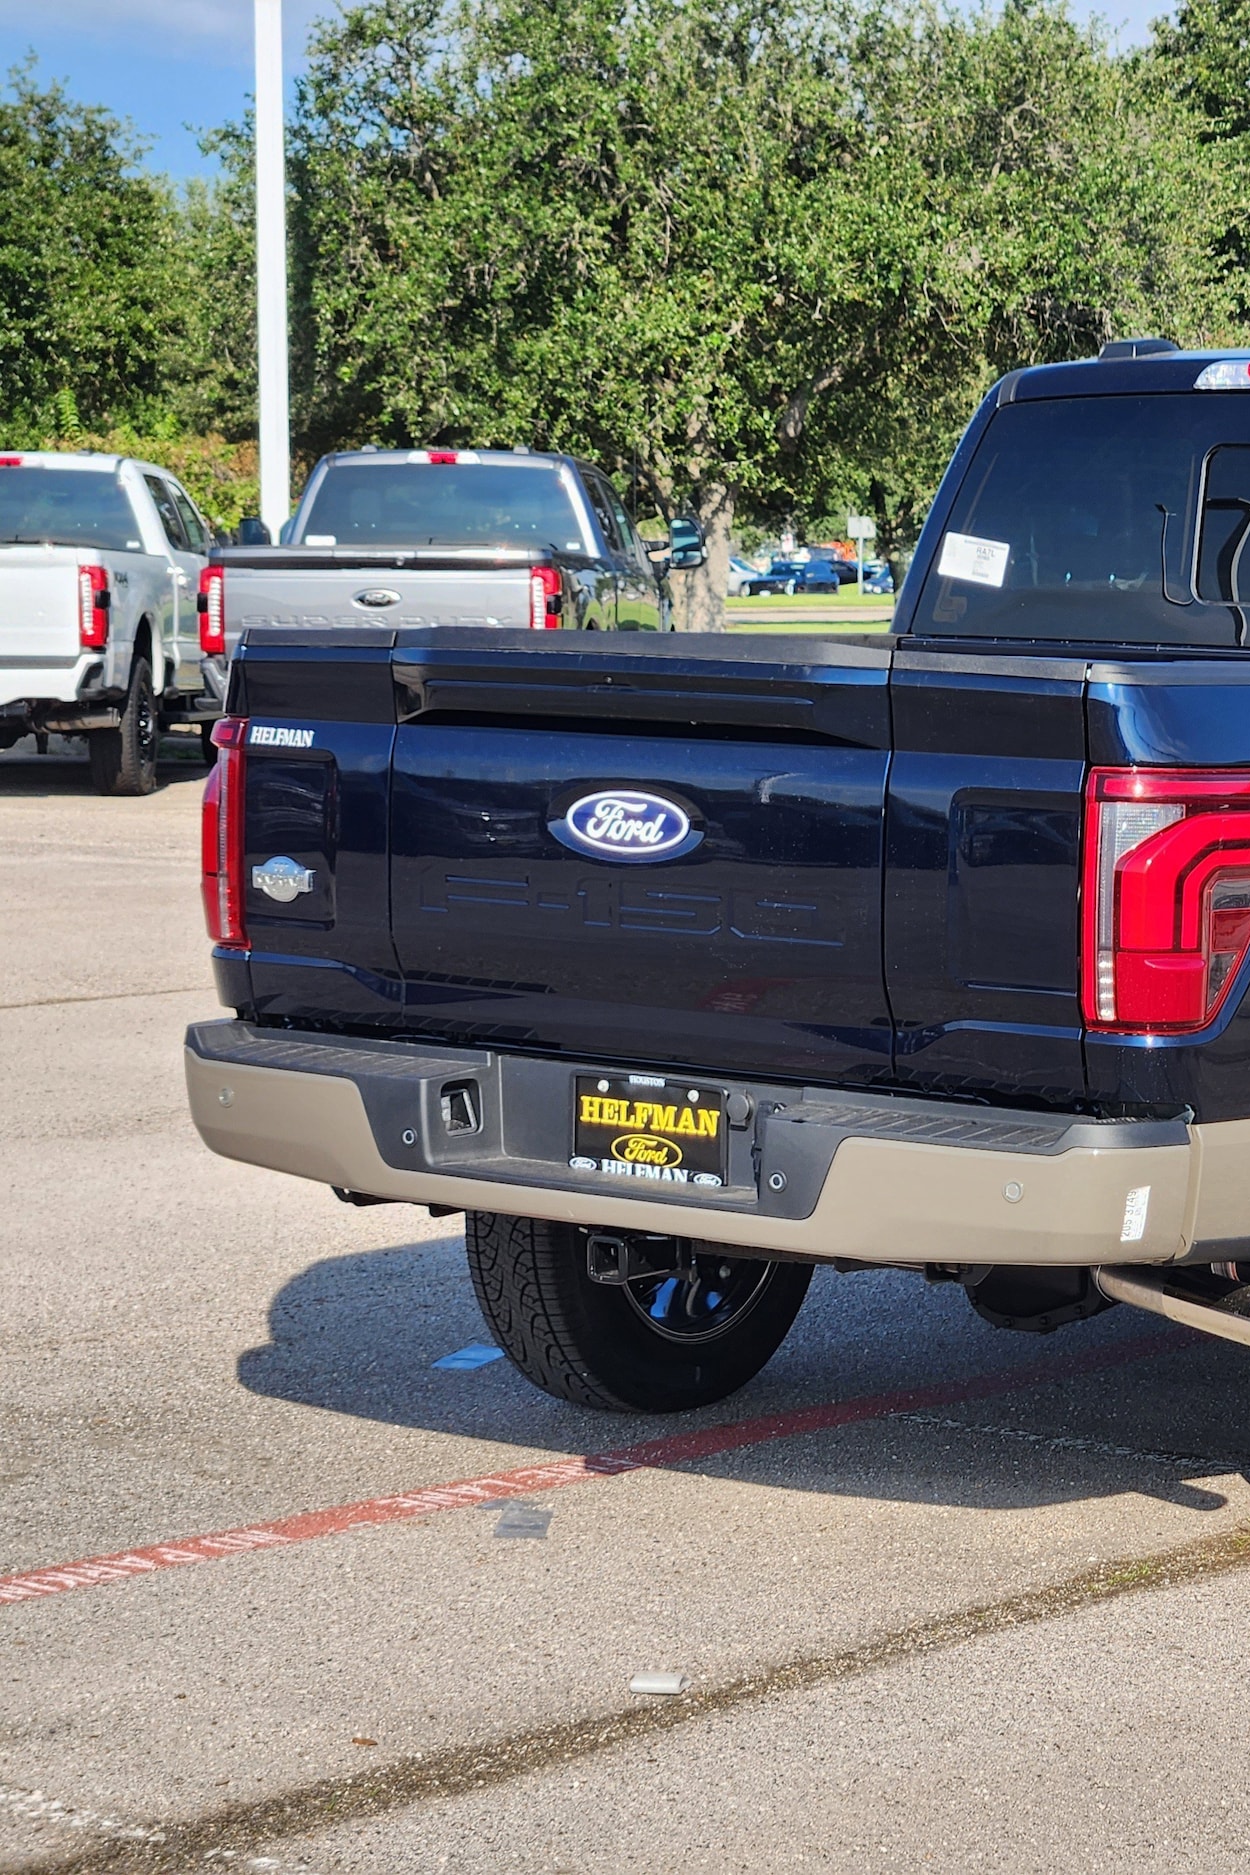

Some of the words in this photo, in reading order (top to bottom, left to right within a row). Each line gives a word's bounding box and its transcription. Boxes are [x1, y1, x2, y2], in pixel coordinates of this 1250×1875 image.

[241, 614, 391, 628] SUPER
[250, 726, 315, 748] HELFMAN
[585, 796, 667, 845] Ford
[579, 1095, 721, 1138] HELFMAN
[623, 1136, 670, 1165] Ford
